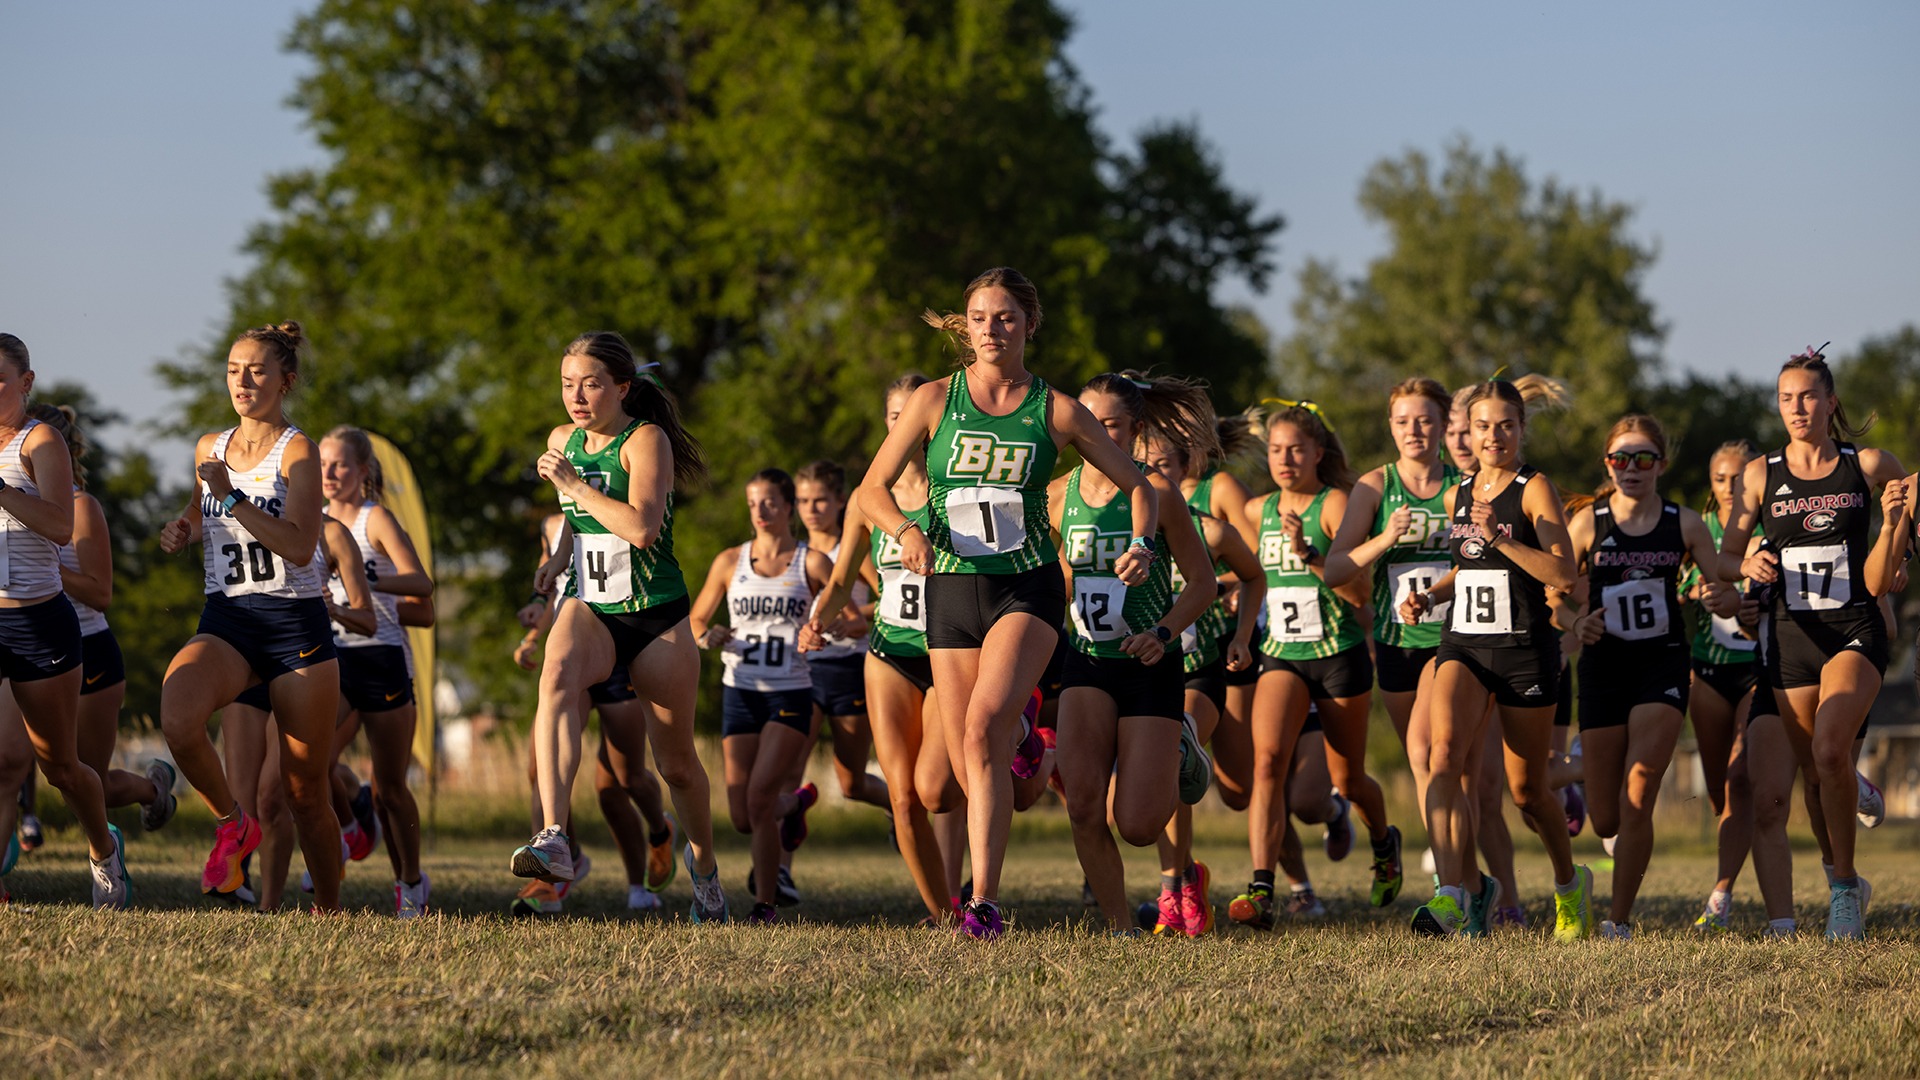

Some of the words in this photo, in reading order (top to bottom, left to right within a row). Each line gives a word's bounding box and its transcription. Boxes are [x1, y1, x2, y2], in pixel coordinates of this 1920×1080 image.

[953, 436, 1029, 483] BH
[201, 492, 282, 518] OURS
[978, 501, 996, 543] 1
[1771, 493, 1864, 518] CHADRON
[221, 541, 276, 586] 30
[1069, 531, 1127, 571] BH
[1263, 535, 1304, 571] BH
[1593, 551, 1681, 567] CHADRON
[586, 550, 608, 593] 4
[1798, 561, 1834, 600] 17
[733, 596, 807, 618] COUGARS
[899, 584, 920, 620] 8
[1080, 592, 1114, 632] 12
[1282, 602, 1302, 634] 2
[1465, 586, 1496, 624] 19
[1617, 593, 1656, 632] 16
[742, 633, 785, 667] 20
